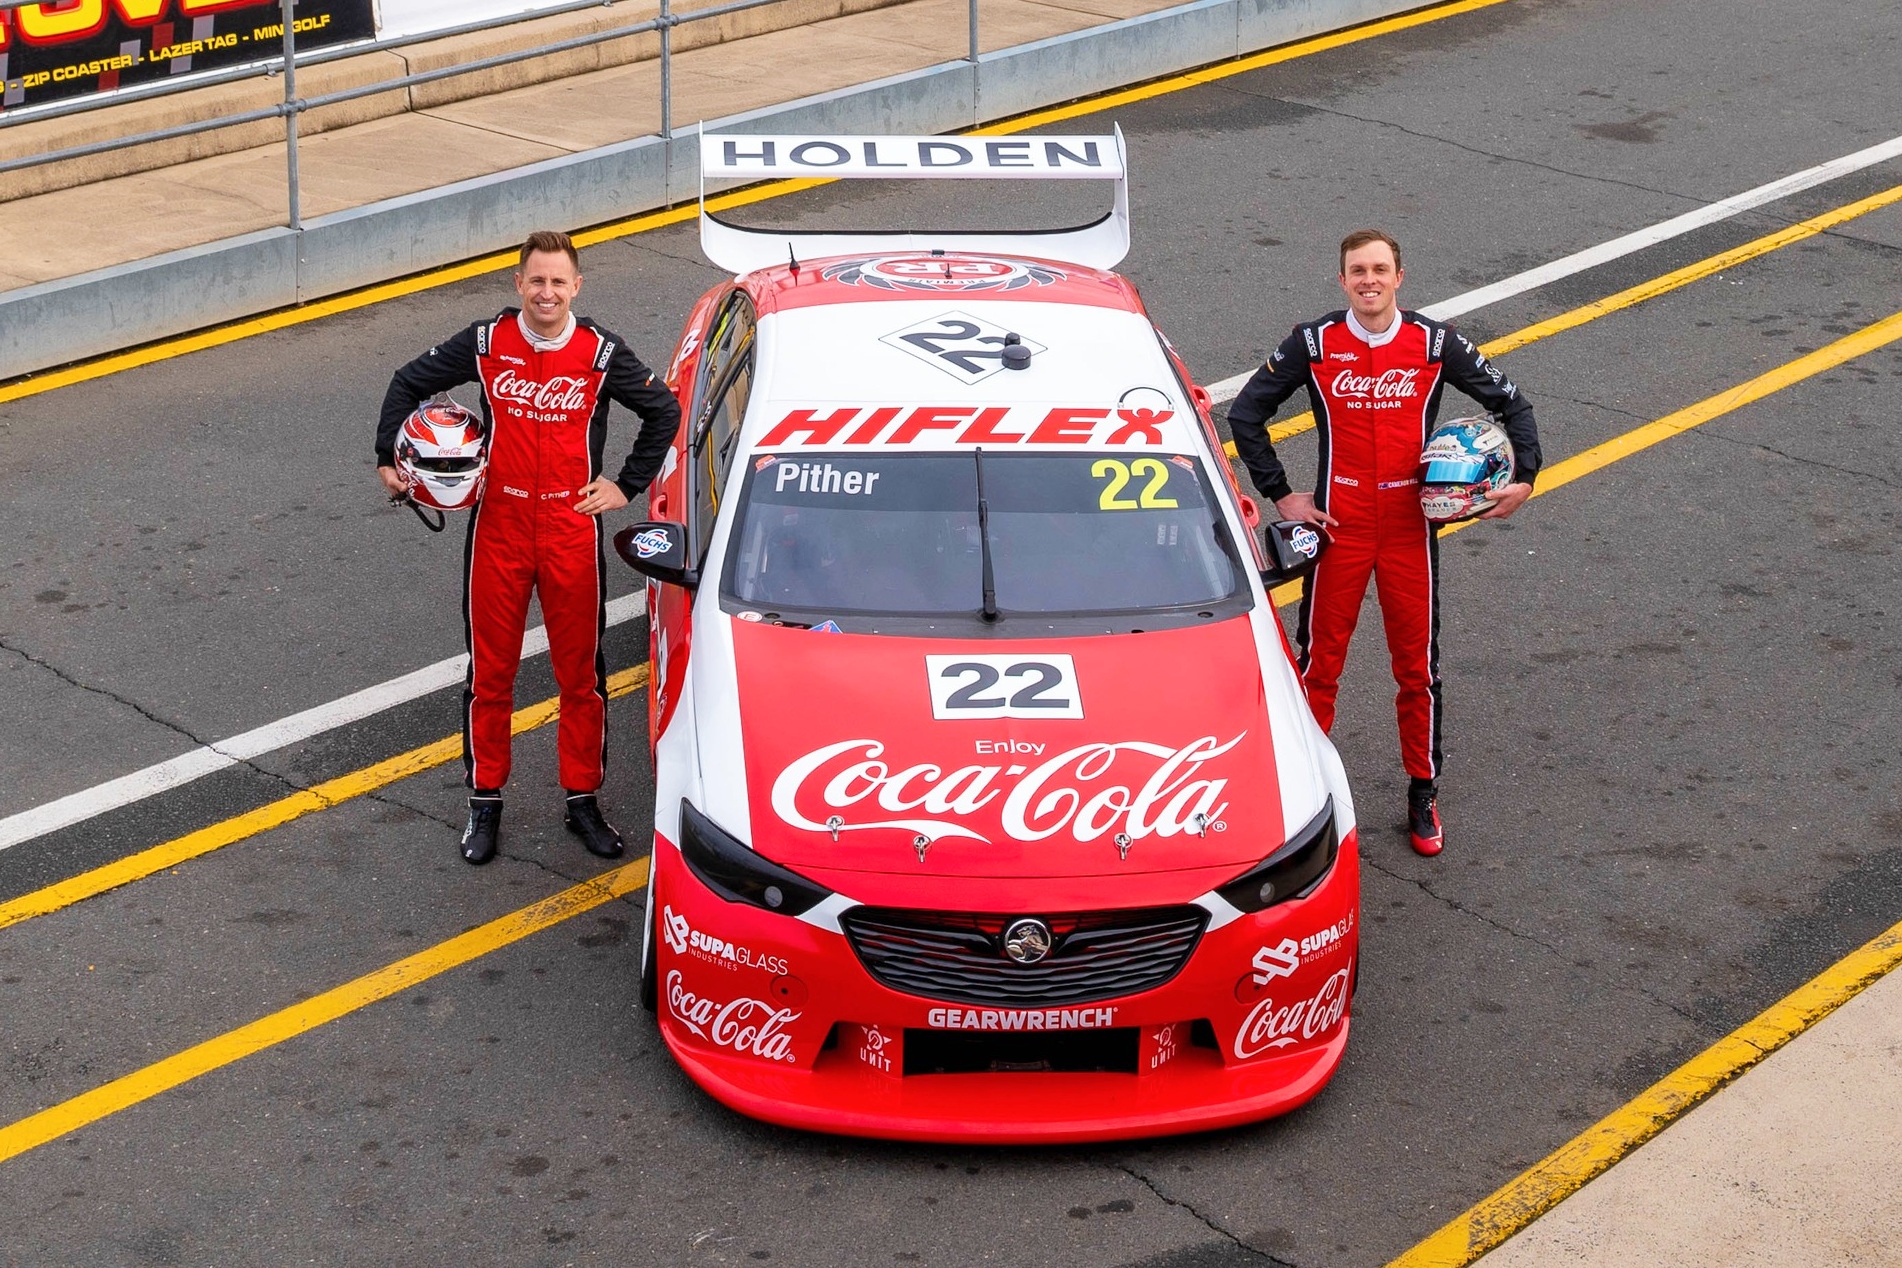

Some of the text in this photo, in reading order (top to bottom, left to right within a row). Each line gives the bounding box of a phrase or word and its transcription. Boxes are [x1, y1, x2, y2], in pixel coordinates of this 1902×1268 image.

[23, 71, 50, 88] ZIP
[53, 54, 133, 81] COASTER
[149, 41, 203, 62] LAZER
[204, 33, 238, 50] TAG
[253, 23, 284, 41] MIN
[723, 140, 1101, 168] HOLDEN
[898, 320, 1004, 374] 22
[492, 369, 590, 410] Coca-Cola
[1331, 368, 1421, 399] Coca-Cola
[507, 406, 568, 422] NO SUGAR
[1346, 401, 1402, 409] NO SUGAR
[755, 407, 1175, 447] HIFLEX
[775, 462, 880, 495] Pither
[1091, 458, 1179, 511] 22
[634, 534, 670, 551] FUCHS
[1292, 532, 1318, 550] FUCHS
[941, 661, 1070, 710] 22
[975, 738, 1046, 756] Enjoy
[771, 729, 1248, 845] Coca-Cola
[688, 947, 738, 972] INDUSTRIES
[689, 930, 788, 976] SUPAGLASS
[1301, 940, 1342, 965] INDUSTRIES
[666, 969, 803, 1061] Coca-Cola
[927, 1007, 1113, 1030] GEARWRENCH
[860, 1047, 892, 1072] UNIT
[1151, 1044, 1177, 1069] UNIT
